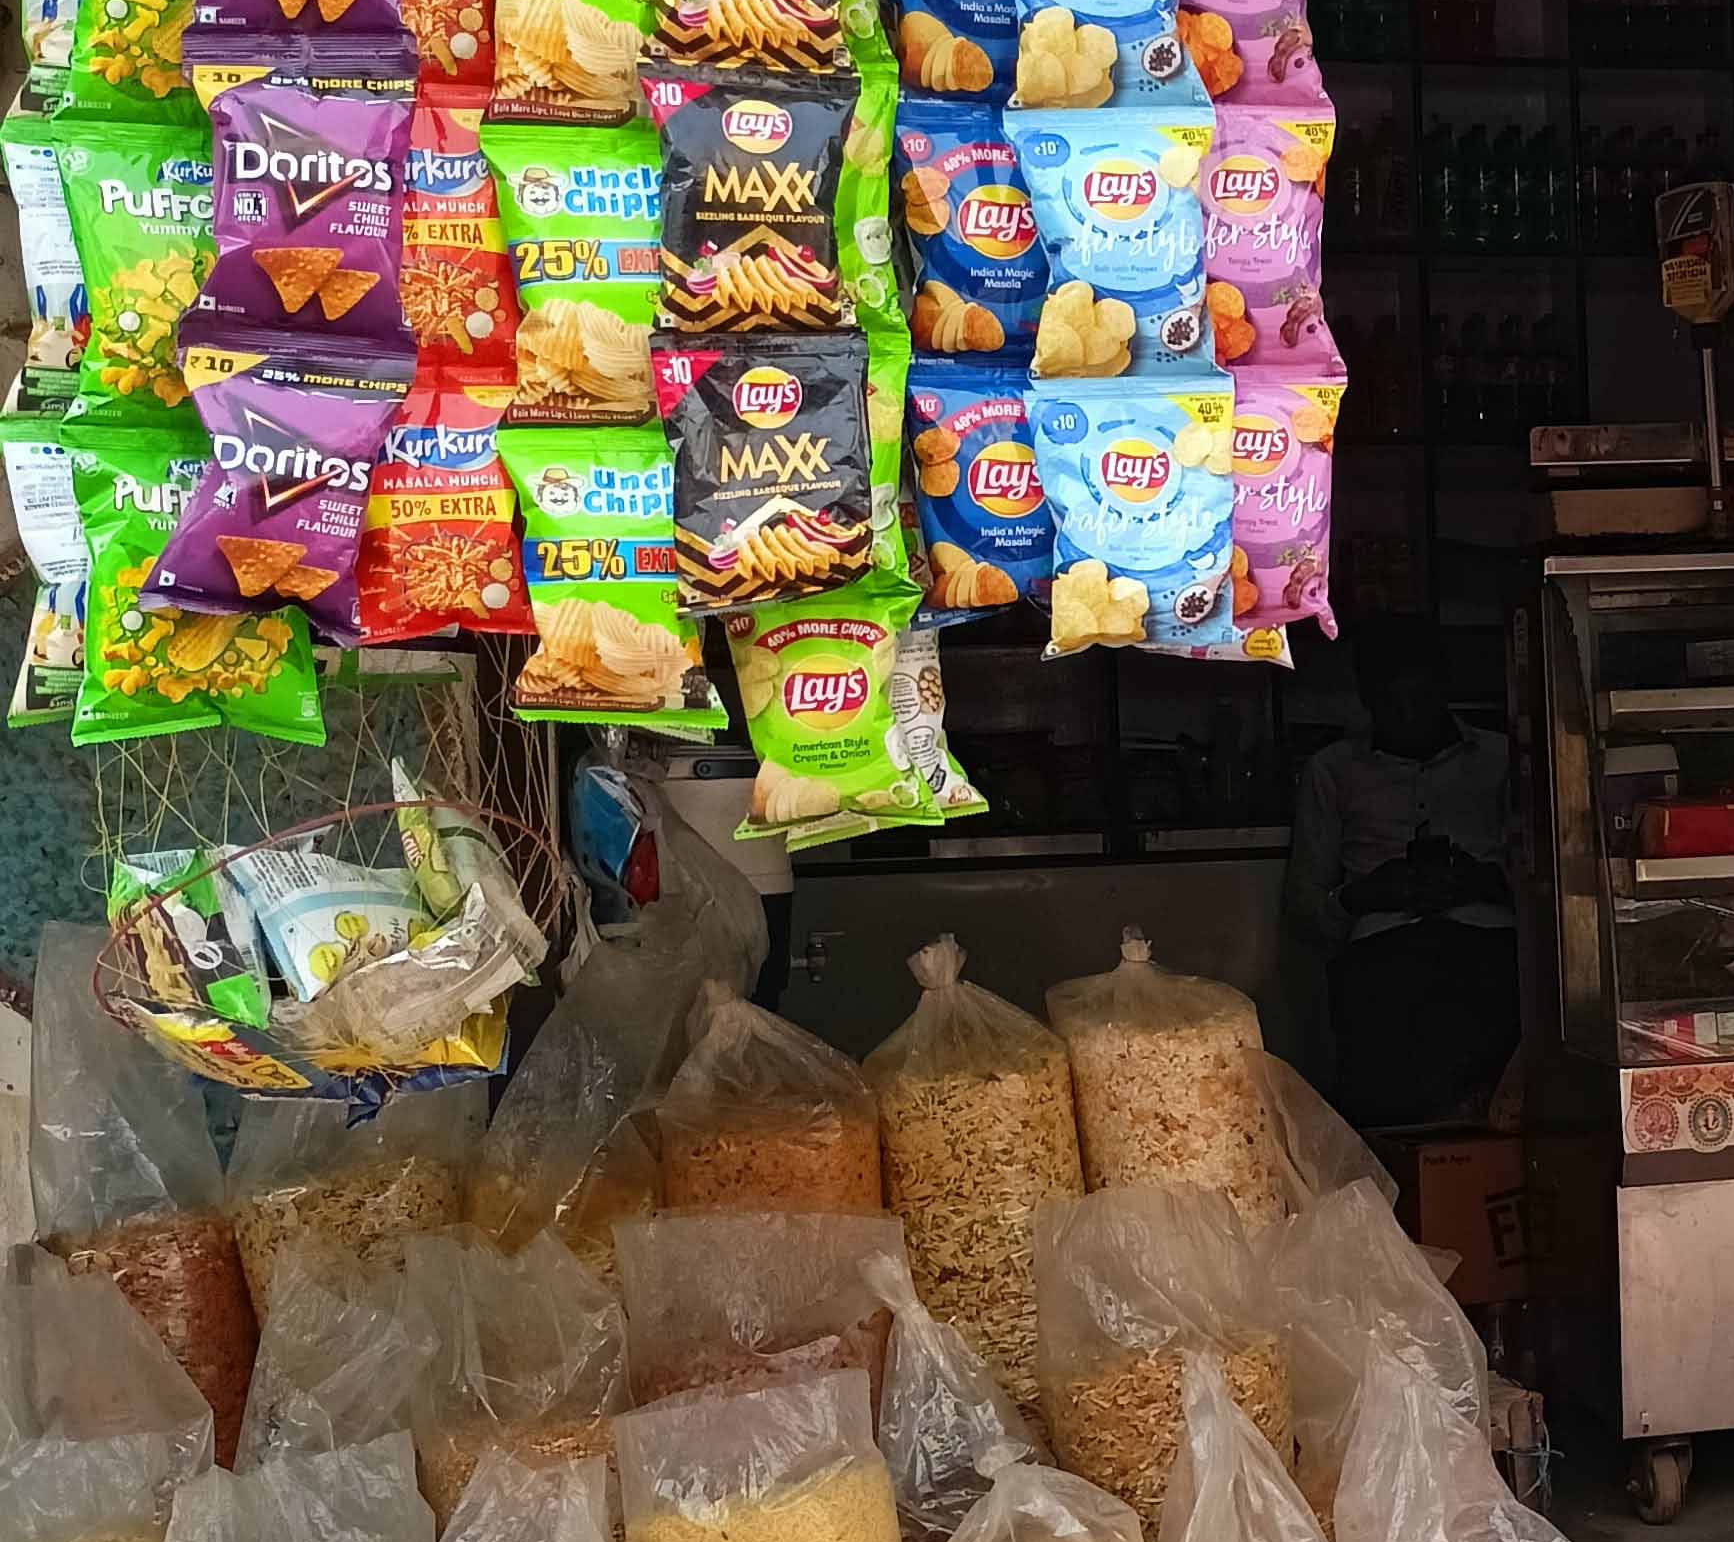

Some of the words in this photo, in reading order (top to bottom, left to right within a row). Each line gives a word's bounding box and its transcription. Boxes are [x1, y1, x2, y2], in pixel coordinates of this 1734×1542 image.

[974, 13, 1011, 25] Masala
[729, 111, 787, 139] Lay's
[972, 149, 1009, 163] MORE
[236, 143, 392, 191] Doritos
[1088, 170, 1154, 204] Lay's
[1215, 170, 1277, 201] Lay's
[348, 201, 391, 215] SWEET
[436, 202, 486, 214] MUNCH
[353, 214, 389, 227] CHILLI
[966, 202, 1035, 239] Lay's
[329, 223, 387, 239] FLAVOUR
[428, 223, 483, 244] EXTRA
[515, 240, 605, 281] 25%
[984, 278, 1021, 290] Masala
[359, 380, 408, 394] CHIPS
[740, 381, 797, 414] Lay's
[983, 405, 1021, 418] MORE
[212, 434, 371, 492] Doritos
[1107, 453, 1169, 488] Lay's
[384, 476, 446, 490] MASALA
[451, 474, 498, 488] MUNCH
[319, 500, 363, 516] SWEET
[391, 498, 431, 519] 50%
[440, 496, 497, 517] EXTRA
[296, 519, 357, 539] FLAVOUR
[1015, 527, 1045, 540] Magic
[995, 536, 1032, 548] Masala
[537, 539, 625, 580] 25%
[767, 629, 795, 649] 40%
[797, 622, 837, 636] MORE
[841, 623, 881, 642] CHIPS
[790, 669, 865, 714] Lay's
[792, 739, 842, 752] American
[844, 737, 869, 749] Style
[793, 752, 827, 764] Cream
[840, 748, 871, 760] Onion
